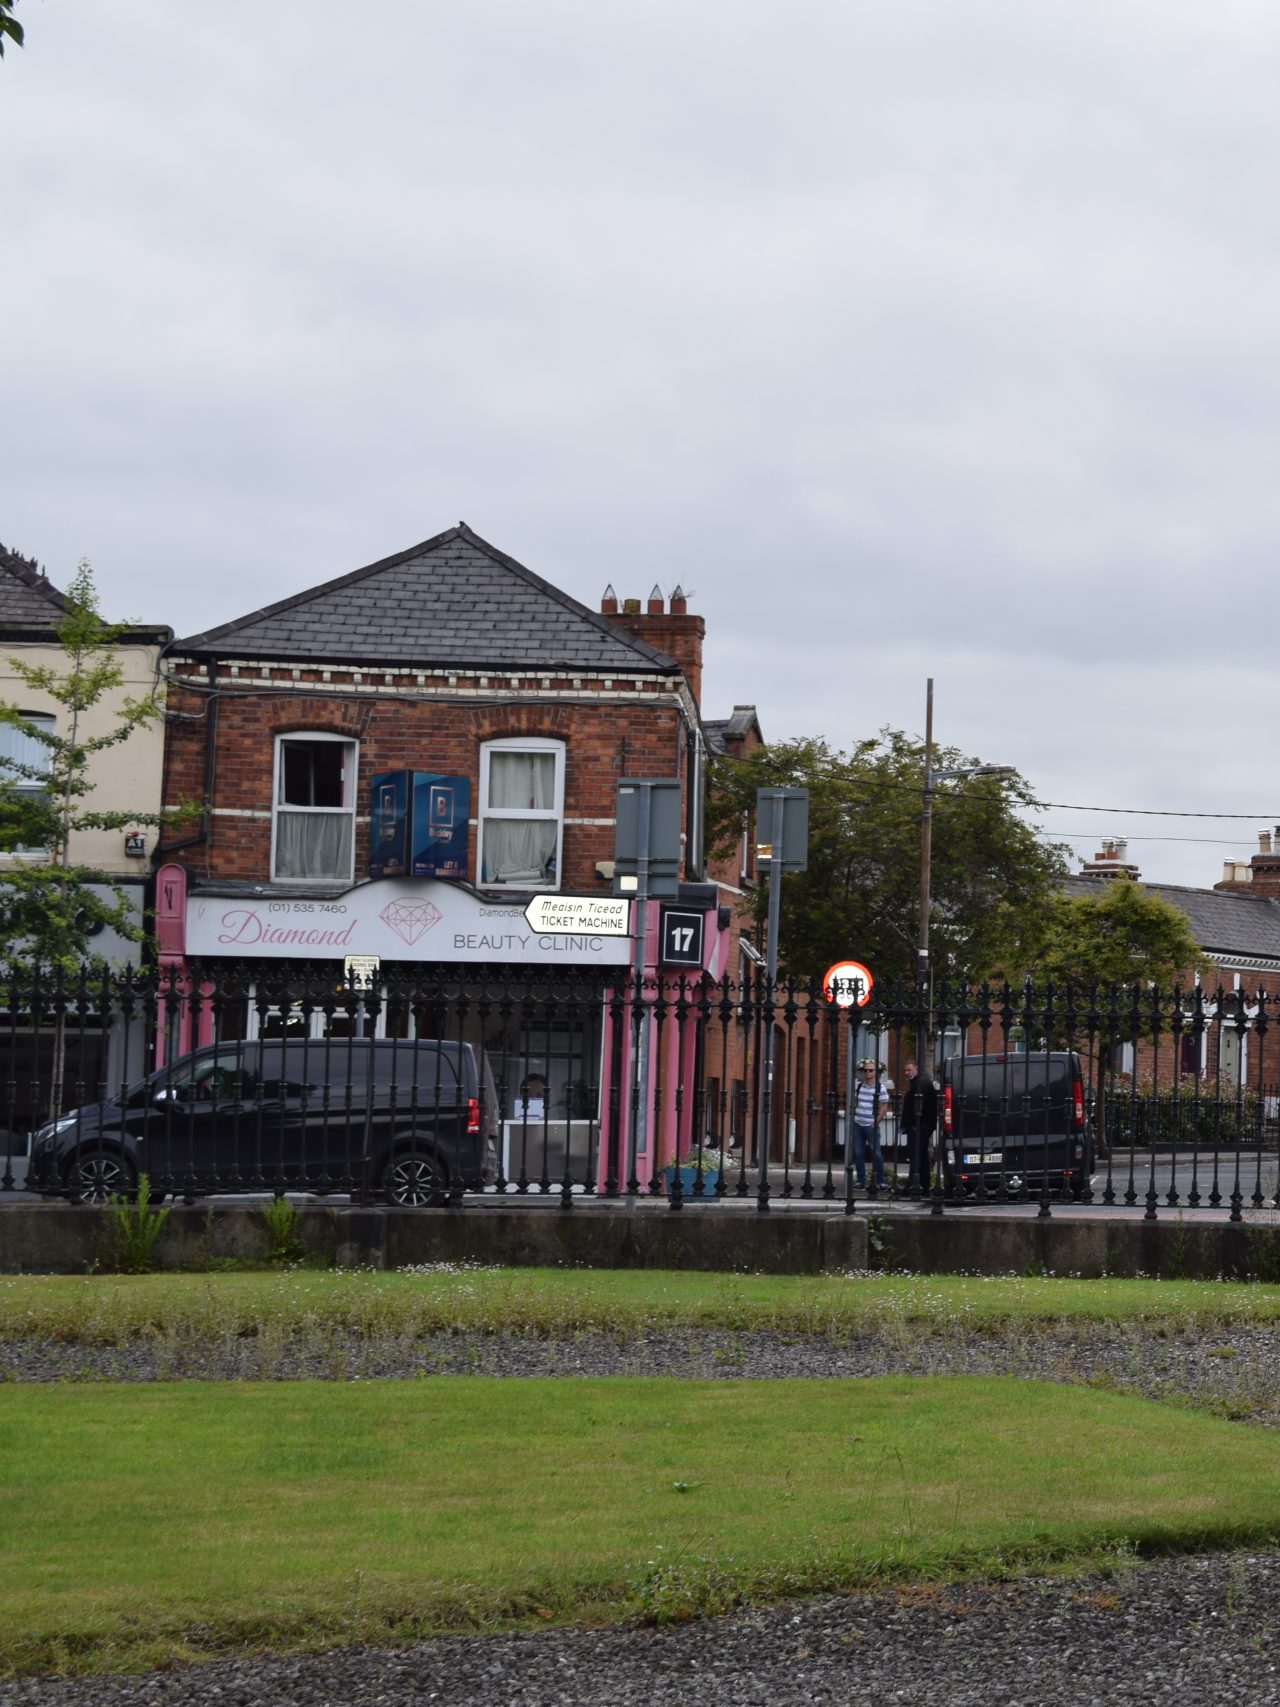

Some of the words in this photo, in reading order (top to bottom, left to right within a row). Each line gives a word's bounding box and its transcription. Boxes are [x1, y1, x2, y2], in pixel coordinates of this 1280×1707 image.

[127, 838, 142, 848] A1
[268, 903, 291, 913] (01)
[293, 903, 315, 913] 535
[319, 904, 347, 914] 7460
[479, 907, 525, 918] DiamondBe
[217, 909, 358, 946] Diamond
[541, 916, 575, 927] TICKET
[578, 917, 624, 929] MACHINE
[453, 934, 530, 950] BEAUTY
[538, 935, 604, 952] CLINIC
[671, 926, 695, 952] 17
